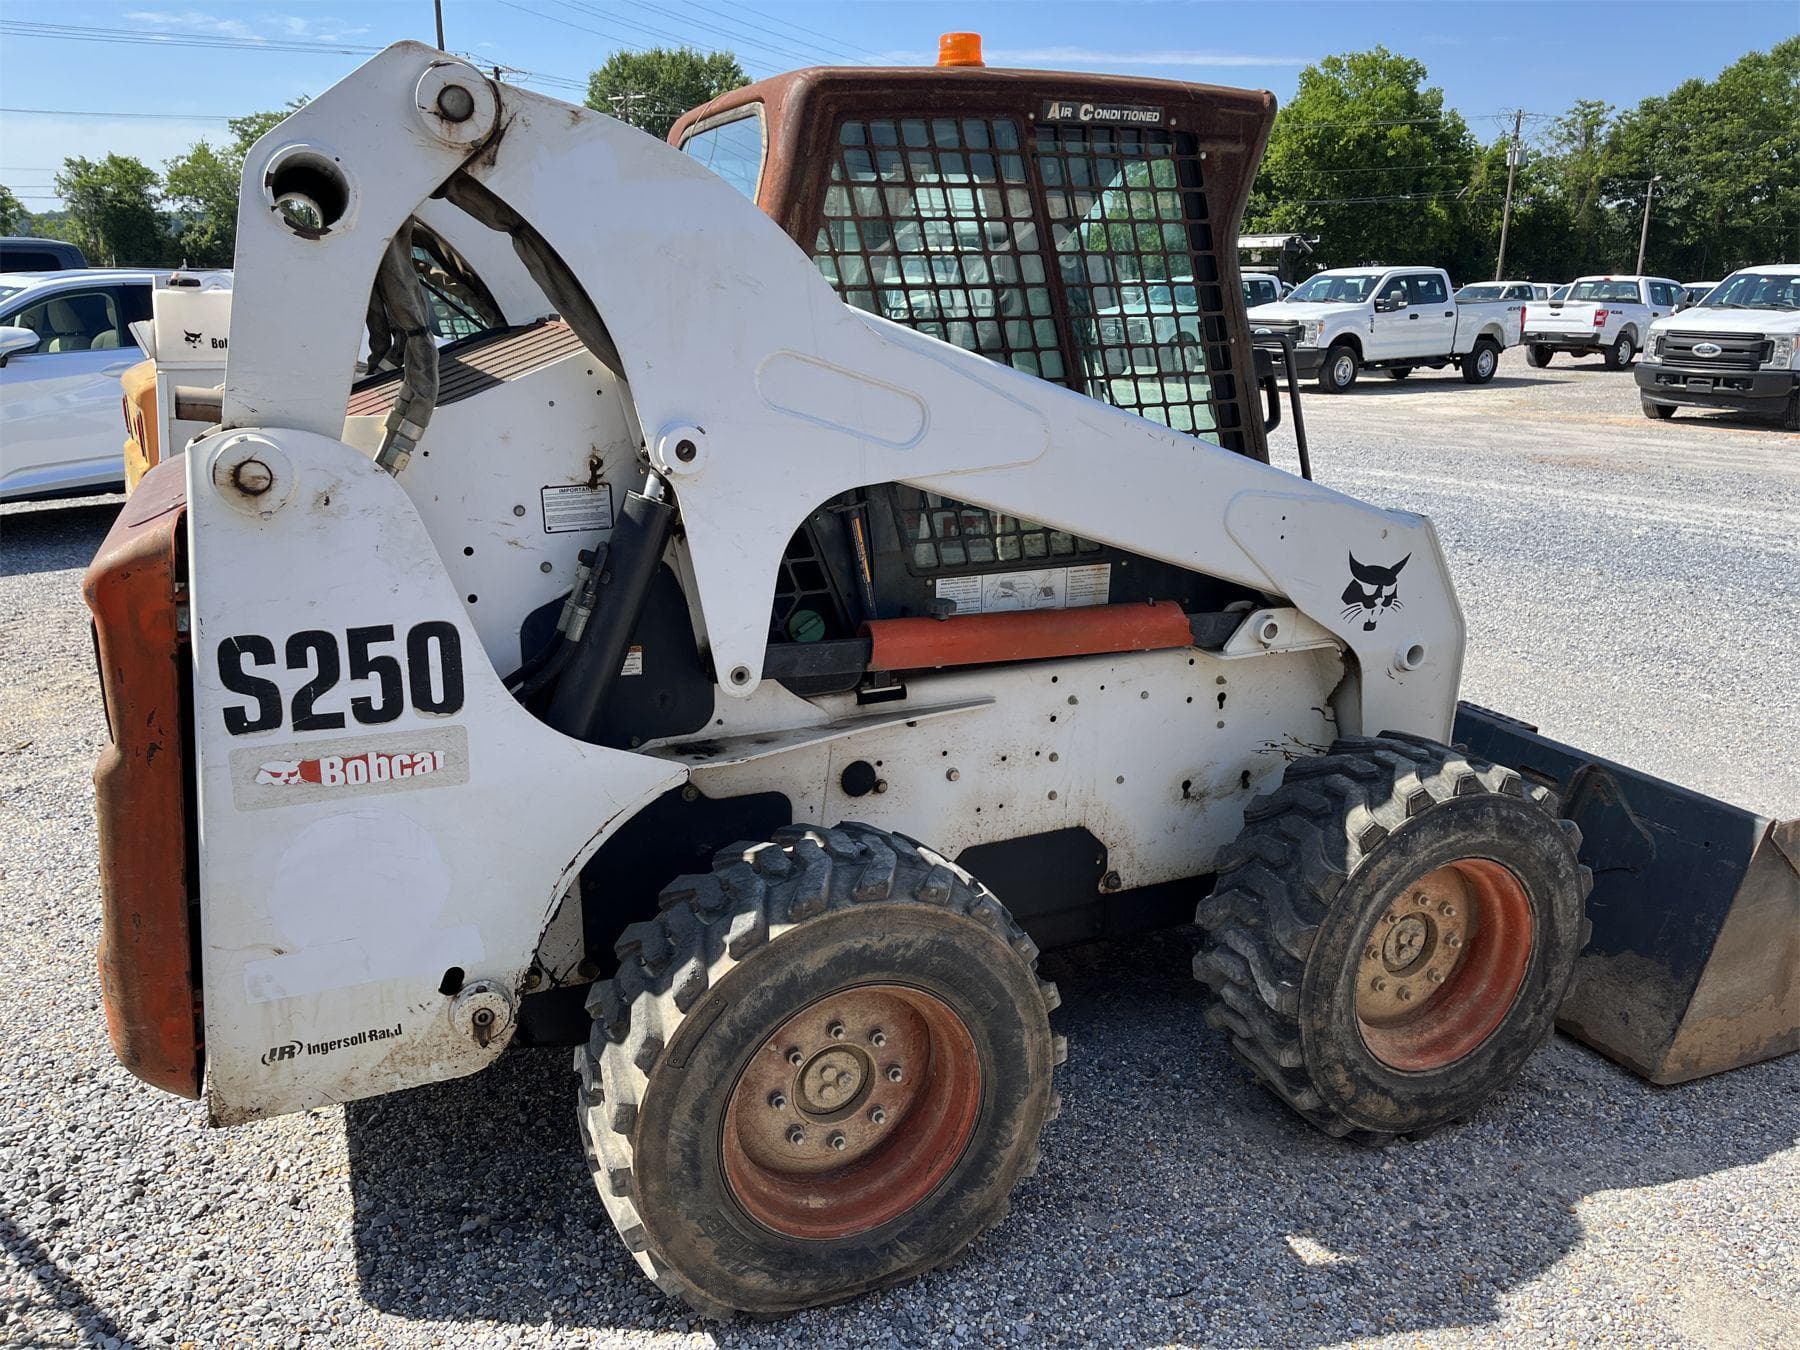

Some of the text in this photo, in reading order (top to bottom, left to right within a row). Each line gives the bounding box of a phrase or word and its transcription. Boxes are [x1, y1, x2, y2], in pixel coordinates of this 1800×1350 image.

[1047, 102, 1160, 122] AIR CONDITIONED
[559, 486, 593, 494] IMPORTAN
[217, 620, 465, 736] S250
[319, 750, 446, 787] Bobcat
